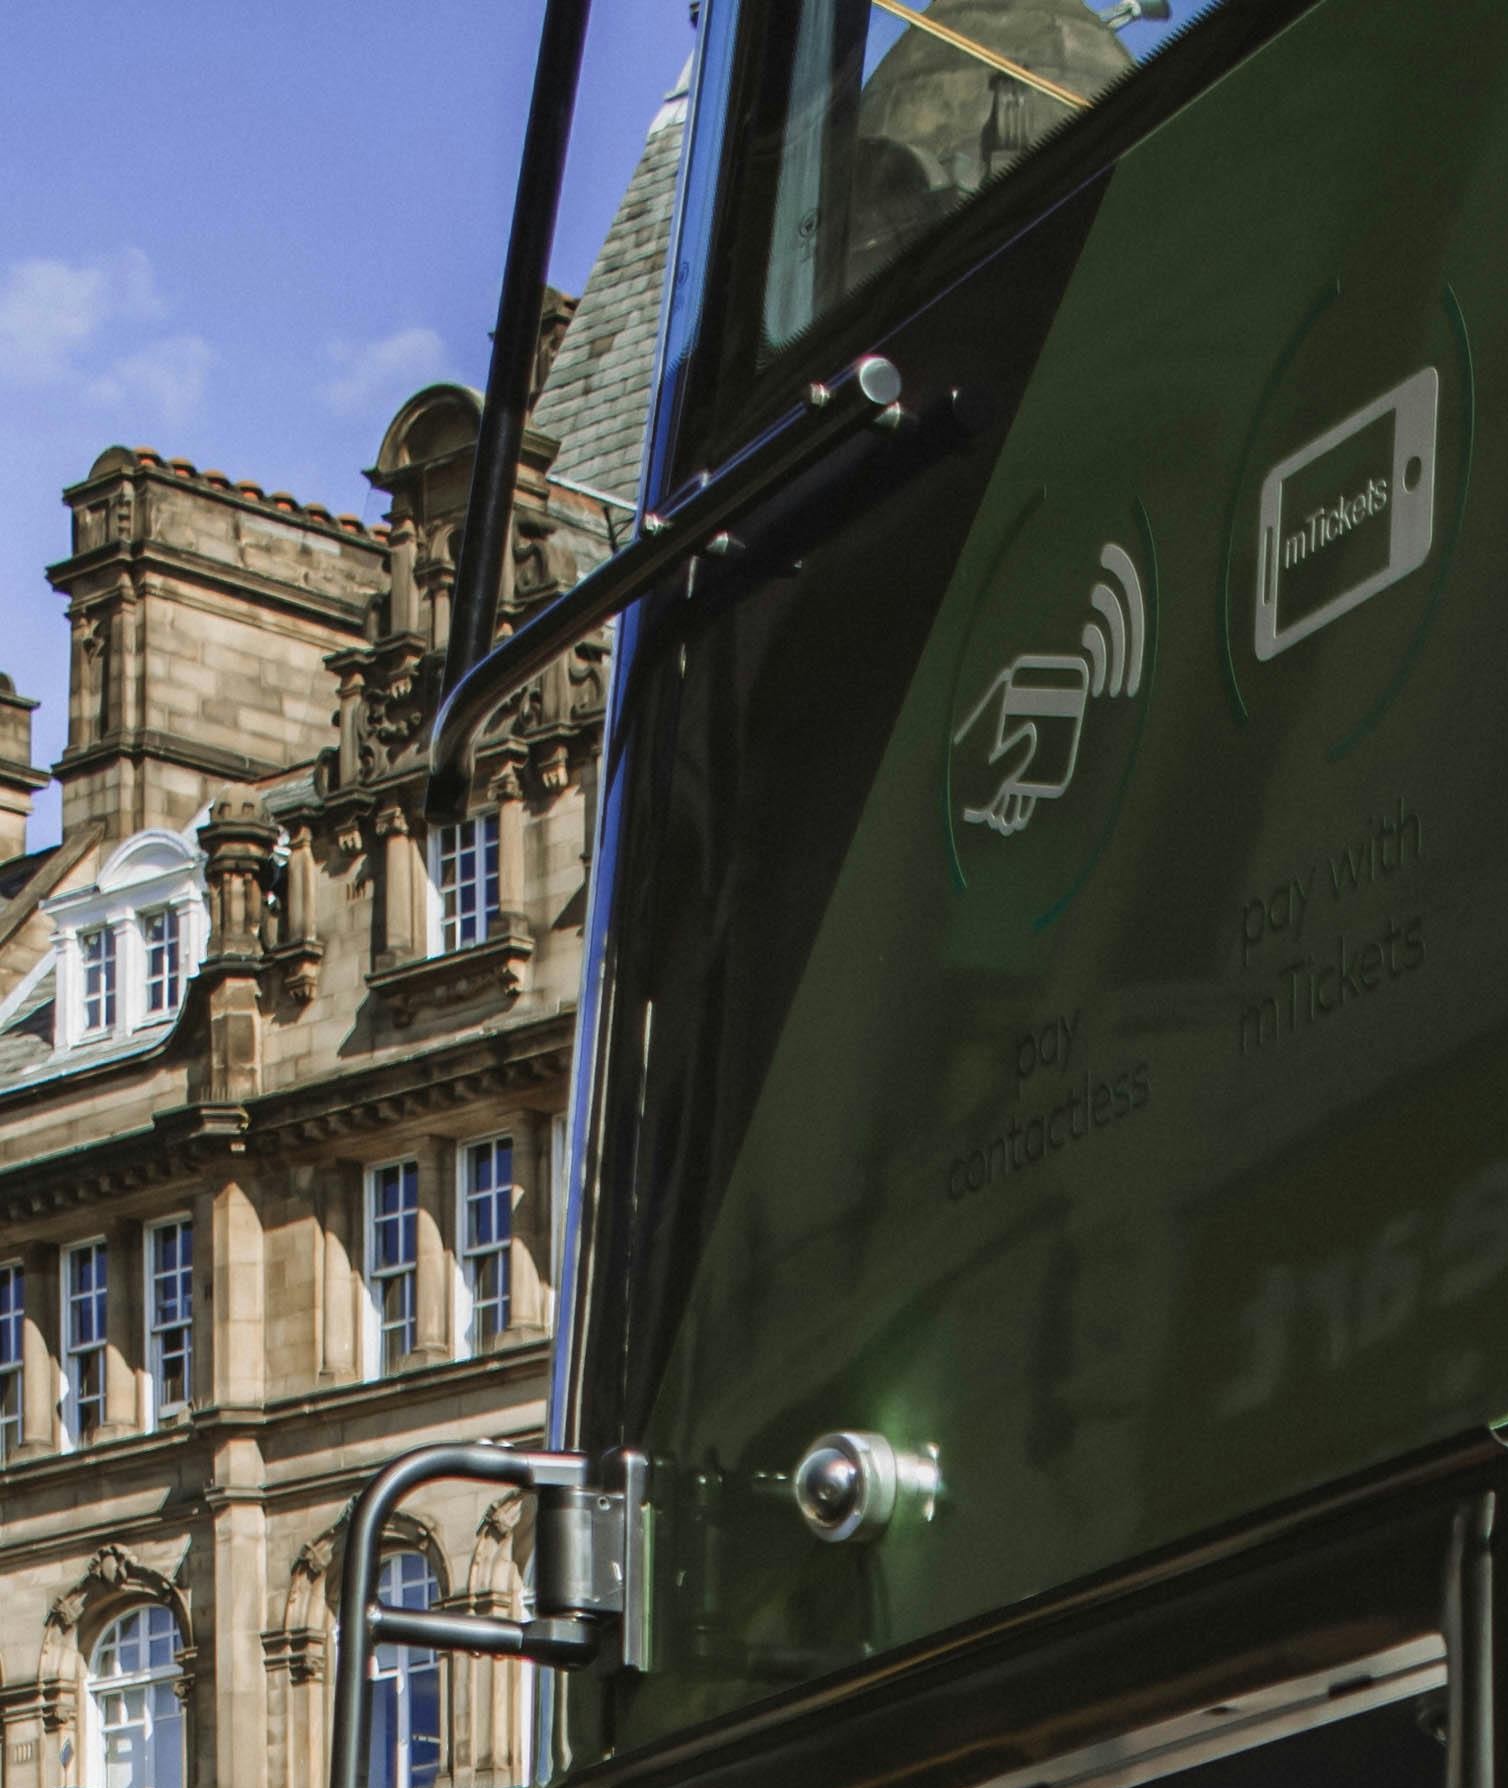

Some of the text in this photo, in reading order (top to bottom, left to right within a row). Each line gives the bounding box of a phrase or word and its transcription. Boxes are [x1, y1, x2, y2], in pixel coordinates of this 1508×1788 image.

[1284, 477, 1388, 570] mTickets
[1237, 797, 1424, 968] pay with
[1011, 1004, 1083, 1102] pay
[1237, 913, 1426, 1057] mTickets
[944, 1059, 1152, 1203] contactless
